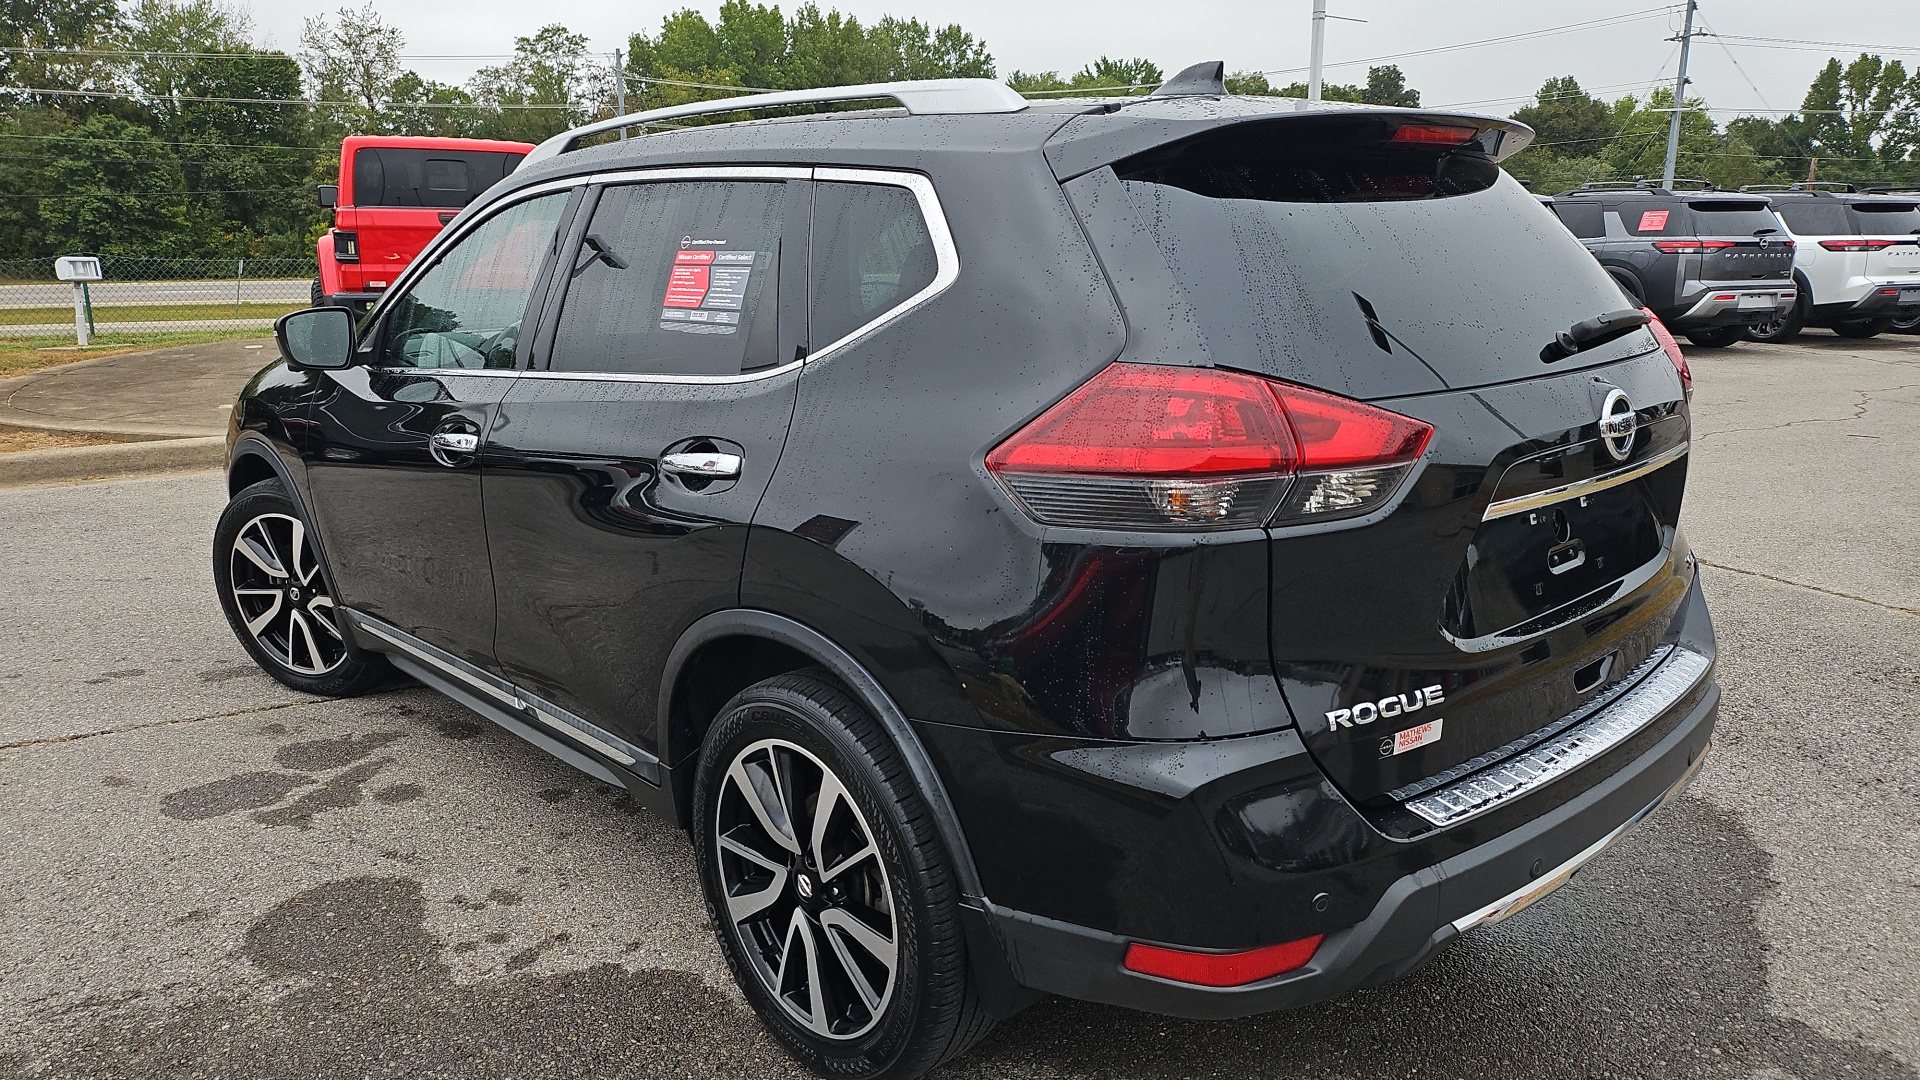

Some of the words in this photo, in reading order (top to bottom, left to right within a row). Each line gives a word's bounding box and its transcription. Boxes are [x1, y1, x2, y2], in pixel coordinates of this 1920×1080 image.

[1323, 684, 1446, 732] ROGUE
[1400, 724, 1432, 740] MATHEWS
[1398, 734, 1423, 748] NISSAN
